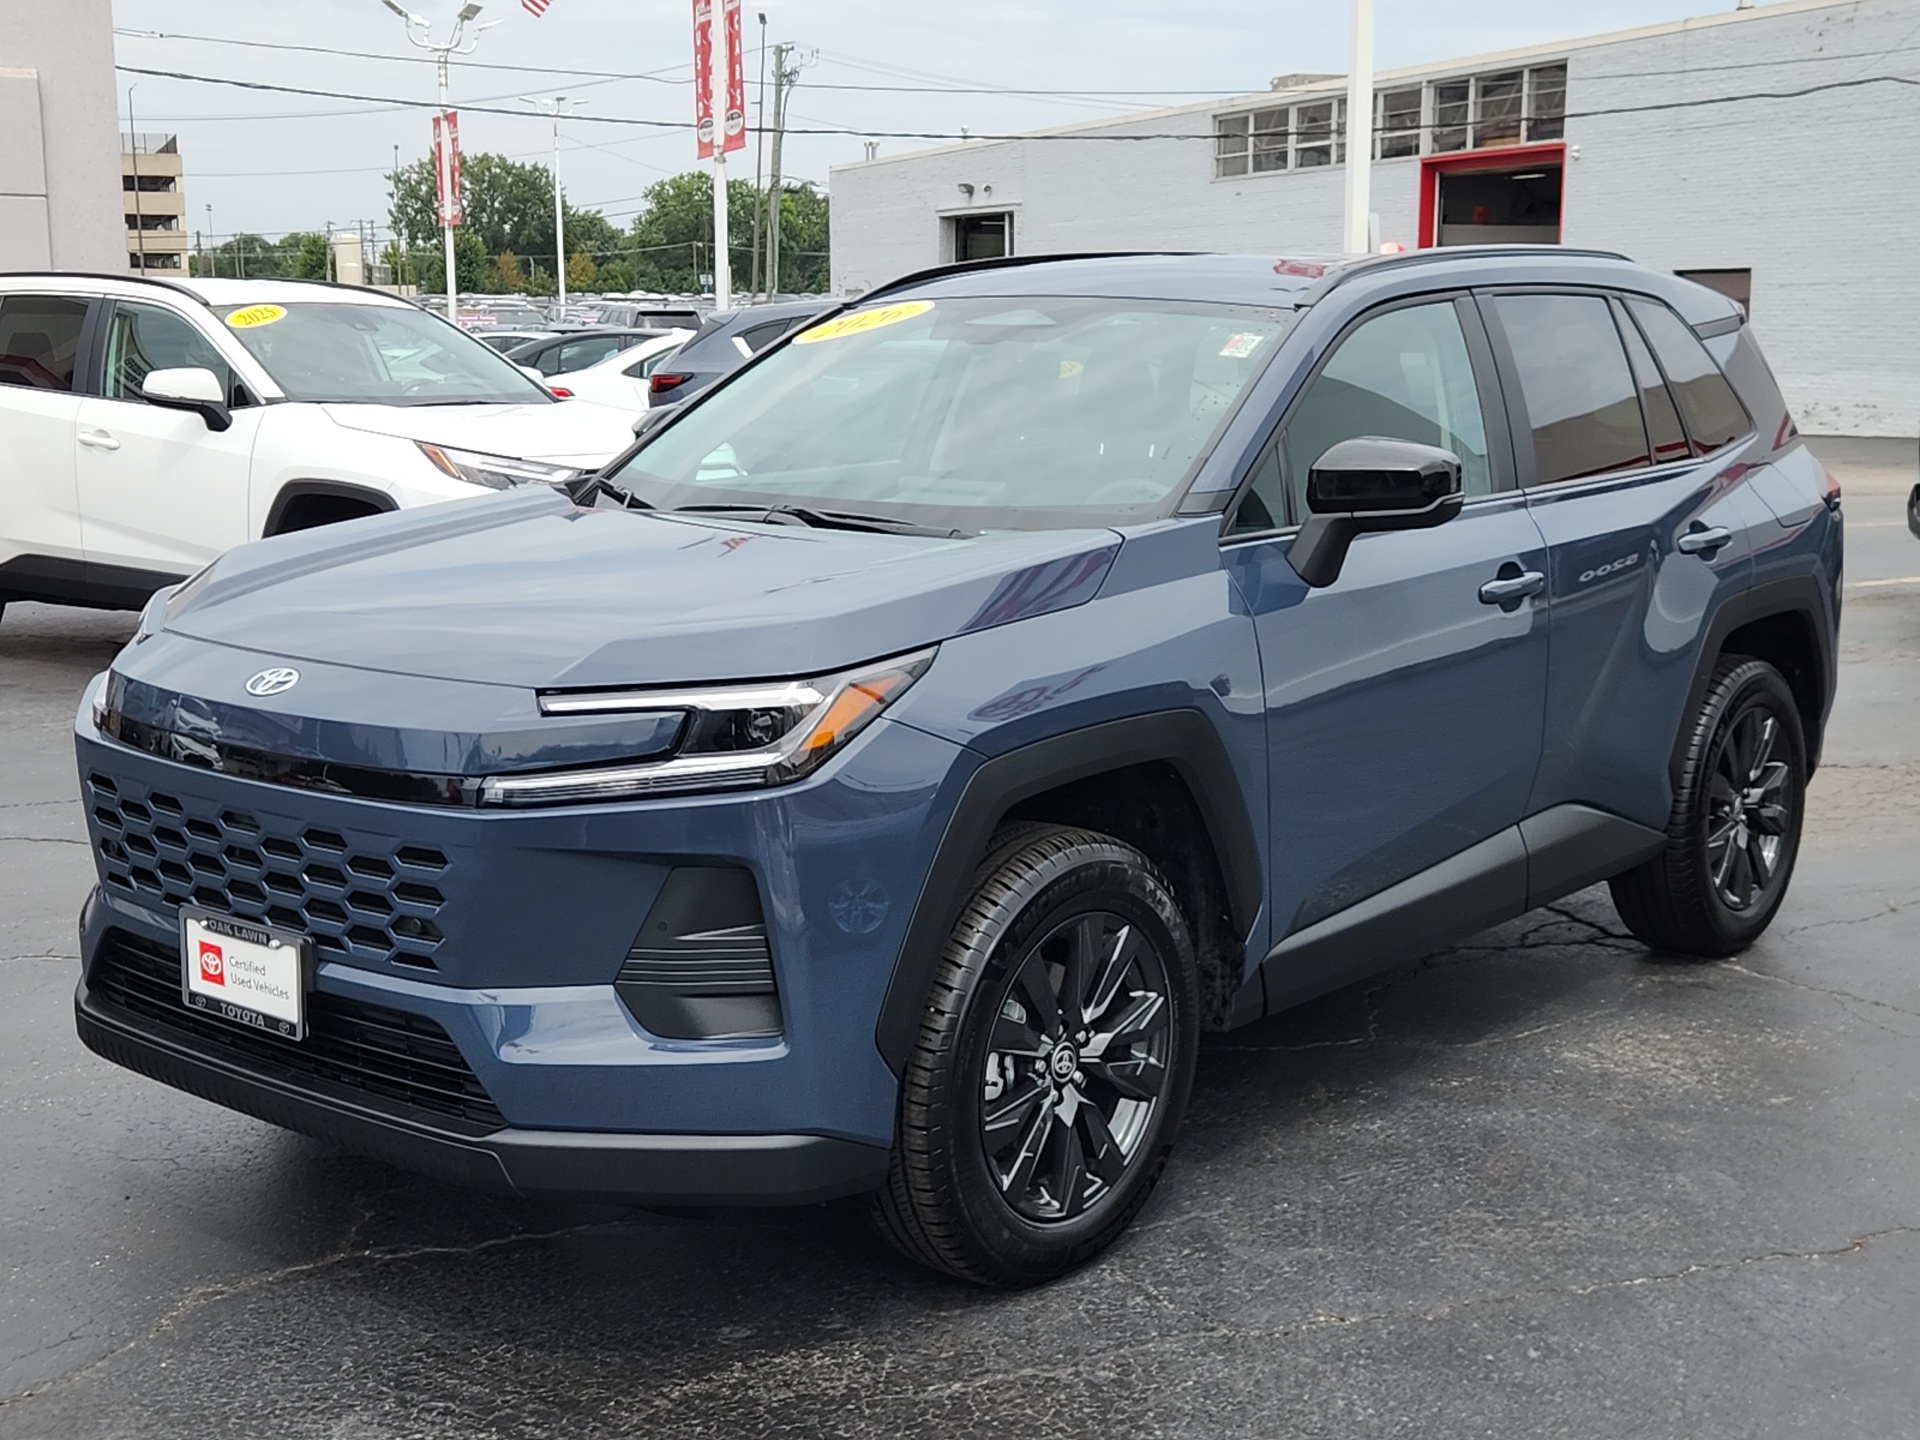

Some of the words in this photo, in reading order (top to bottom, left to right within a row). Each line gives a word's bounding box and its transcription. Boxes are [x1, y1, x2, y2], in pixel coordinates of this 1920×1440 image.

[696, 30, 704, 117] USED
[237, 307, 276, 325] 2025
[208, 919, 233, 936] OAK
[234, 926, 268, 944] LAWN
[228, 955, 266, 976] Certified
[230, 972, 252, 989] Used
[252, 979, 290, 1000] Vehicles
[220, 1002, 265, 1028] TOYOTA
